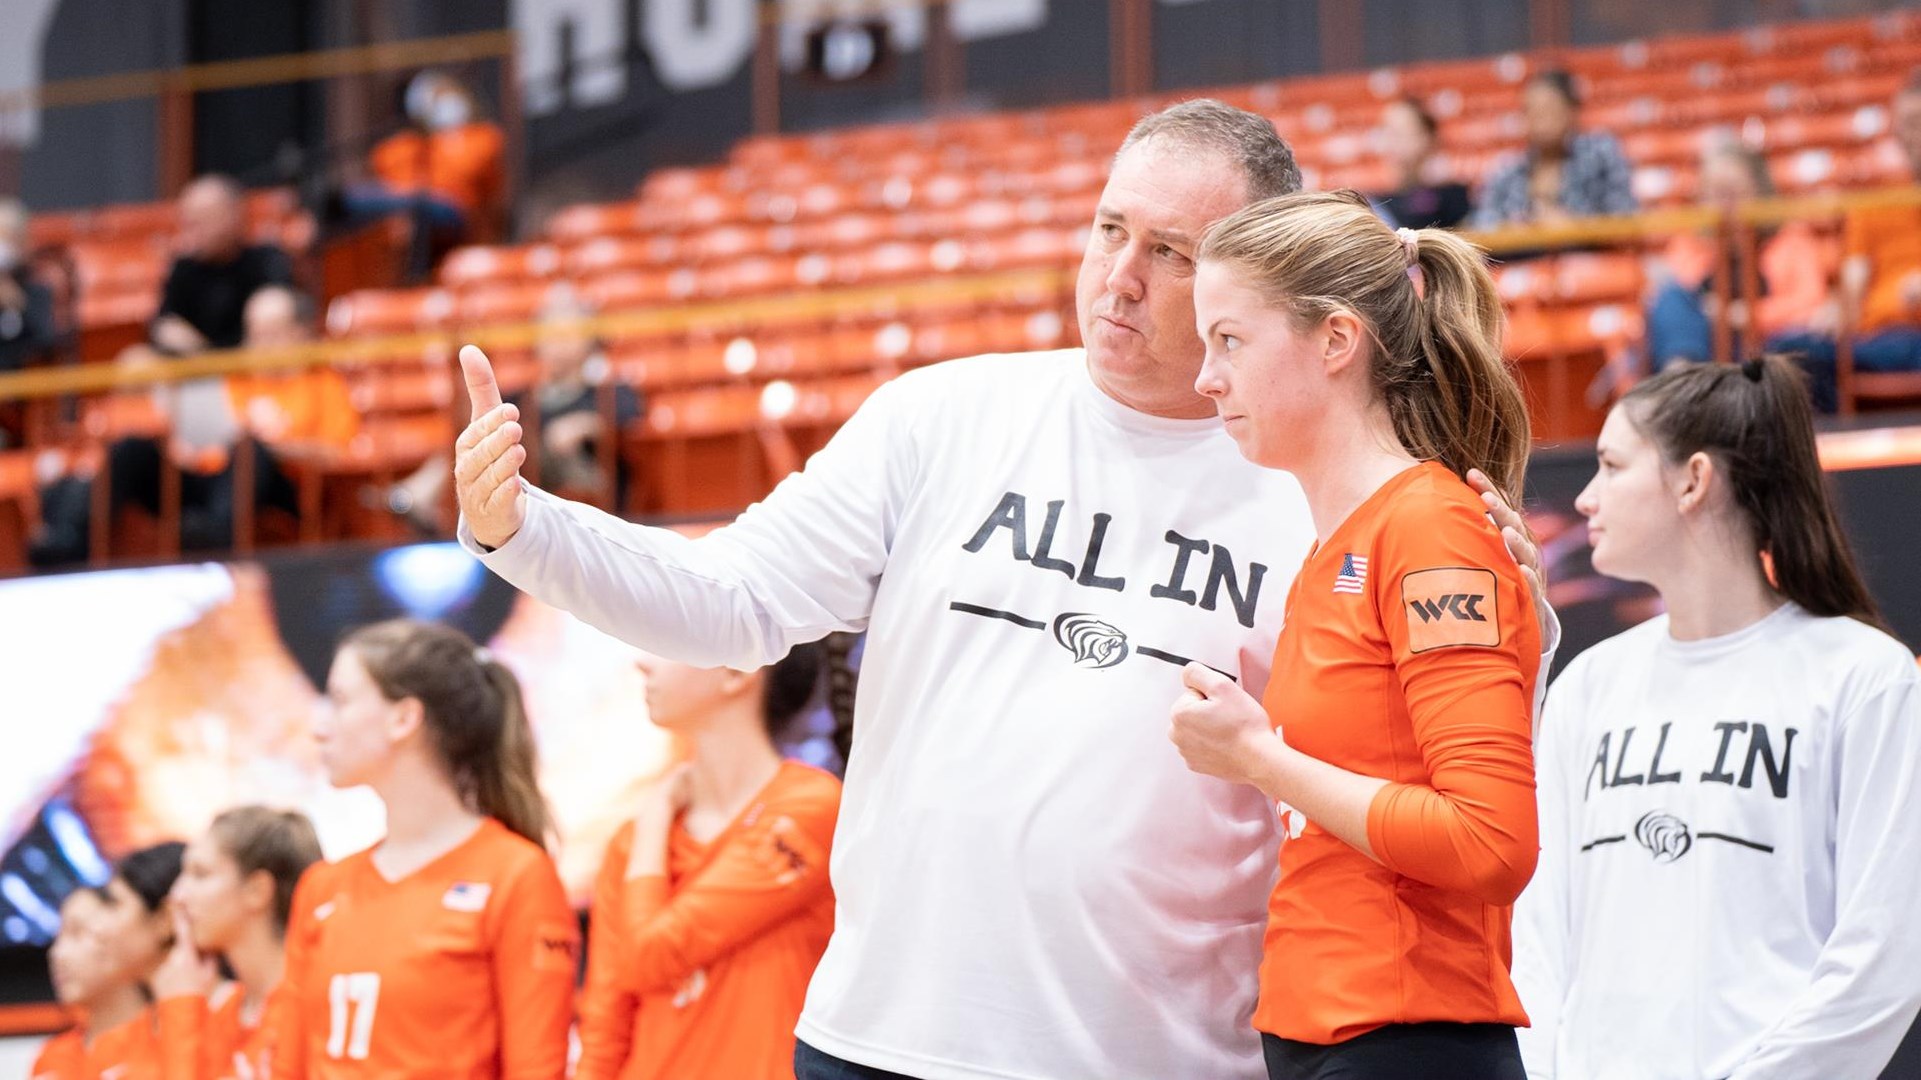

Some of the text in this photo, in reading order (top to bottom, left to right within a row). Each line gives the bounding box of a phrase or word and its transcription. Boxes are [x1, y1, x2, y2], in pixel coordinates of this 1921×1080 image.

[961, 491, 1268, 629] ALL IN
[1409, 593, 1488, 624] WCC
[1584, 721, 1799, 802] ALL IN
[326, 972, 382, 1060] 17
